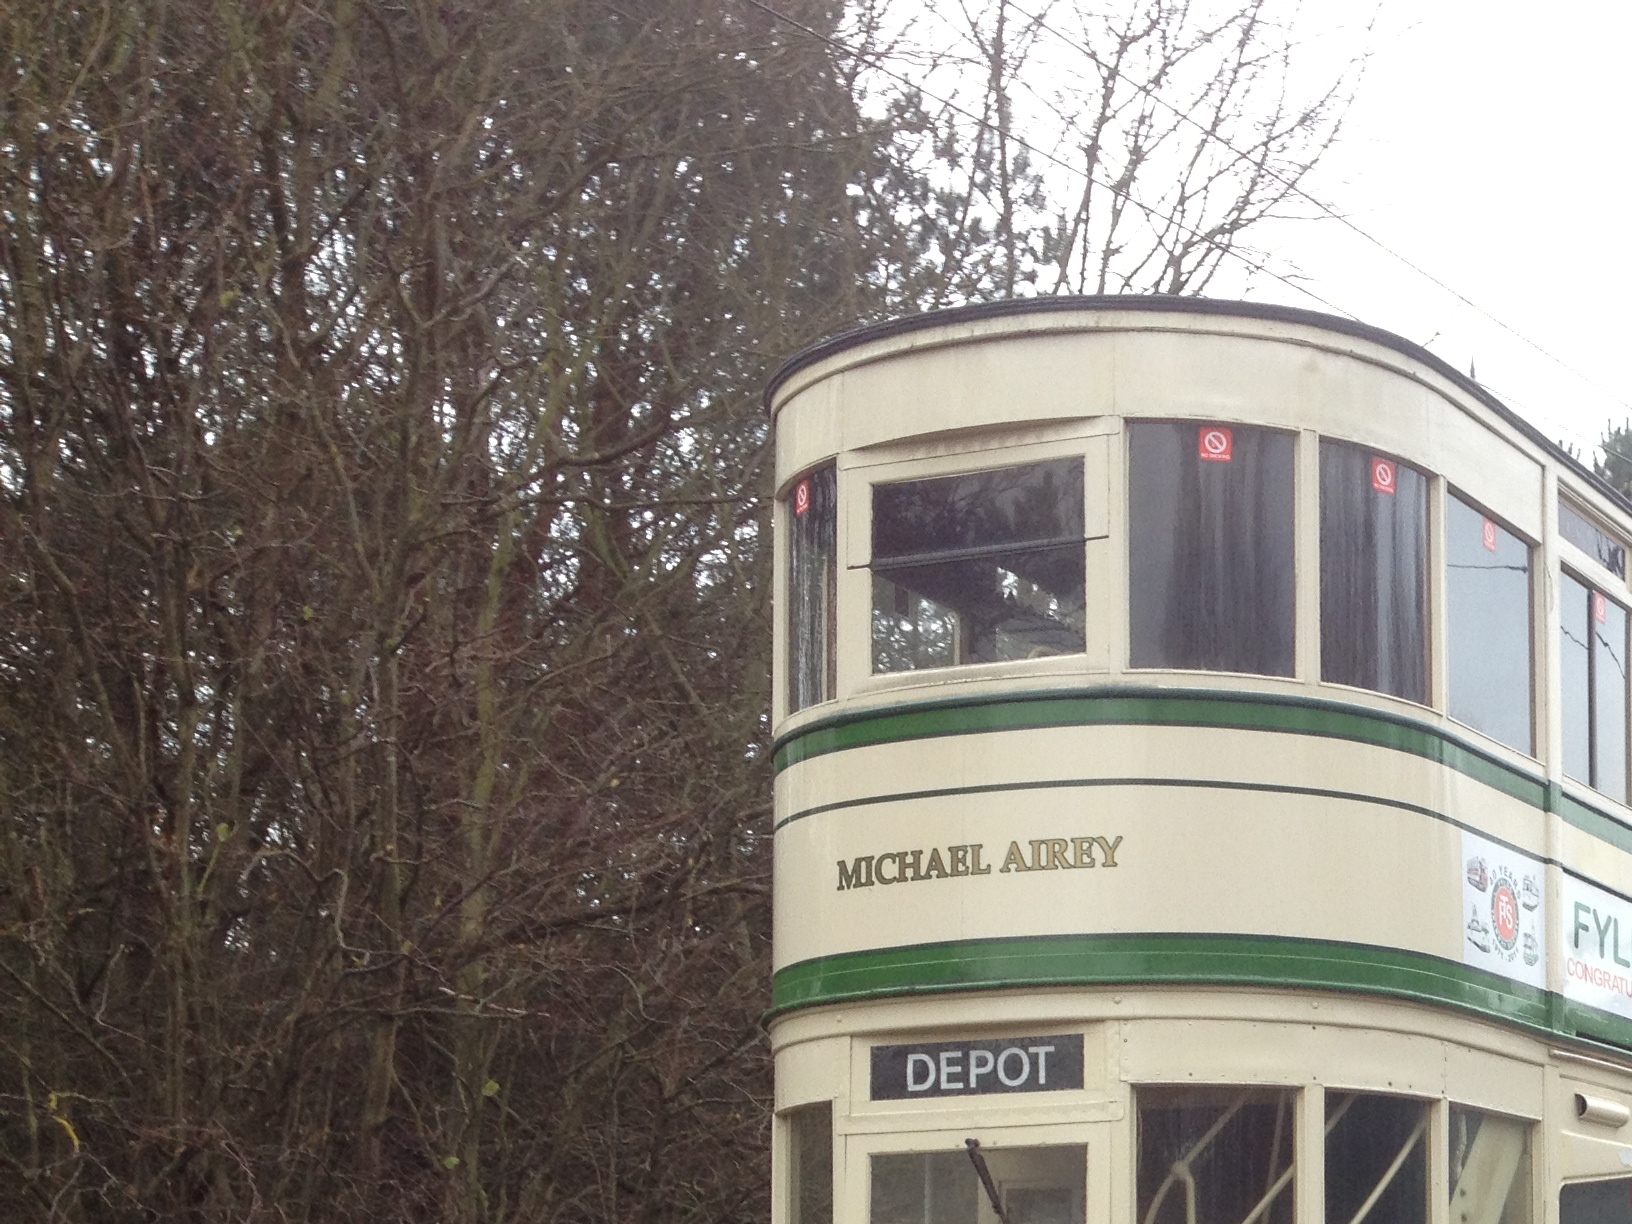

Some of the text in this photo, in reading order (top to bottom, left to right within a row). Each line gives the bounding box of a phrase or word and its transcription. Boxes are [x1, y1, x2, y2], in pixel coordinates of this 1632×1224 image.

[836, 836, 1123, 891] MICHAEL AIREY
[906, 1045, 1055, 1092] DEPOT
